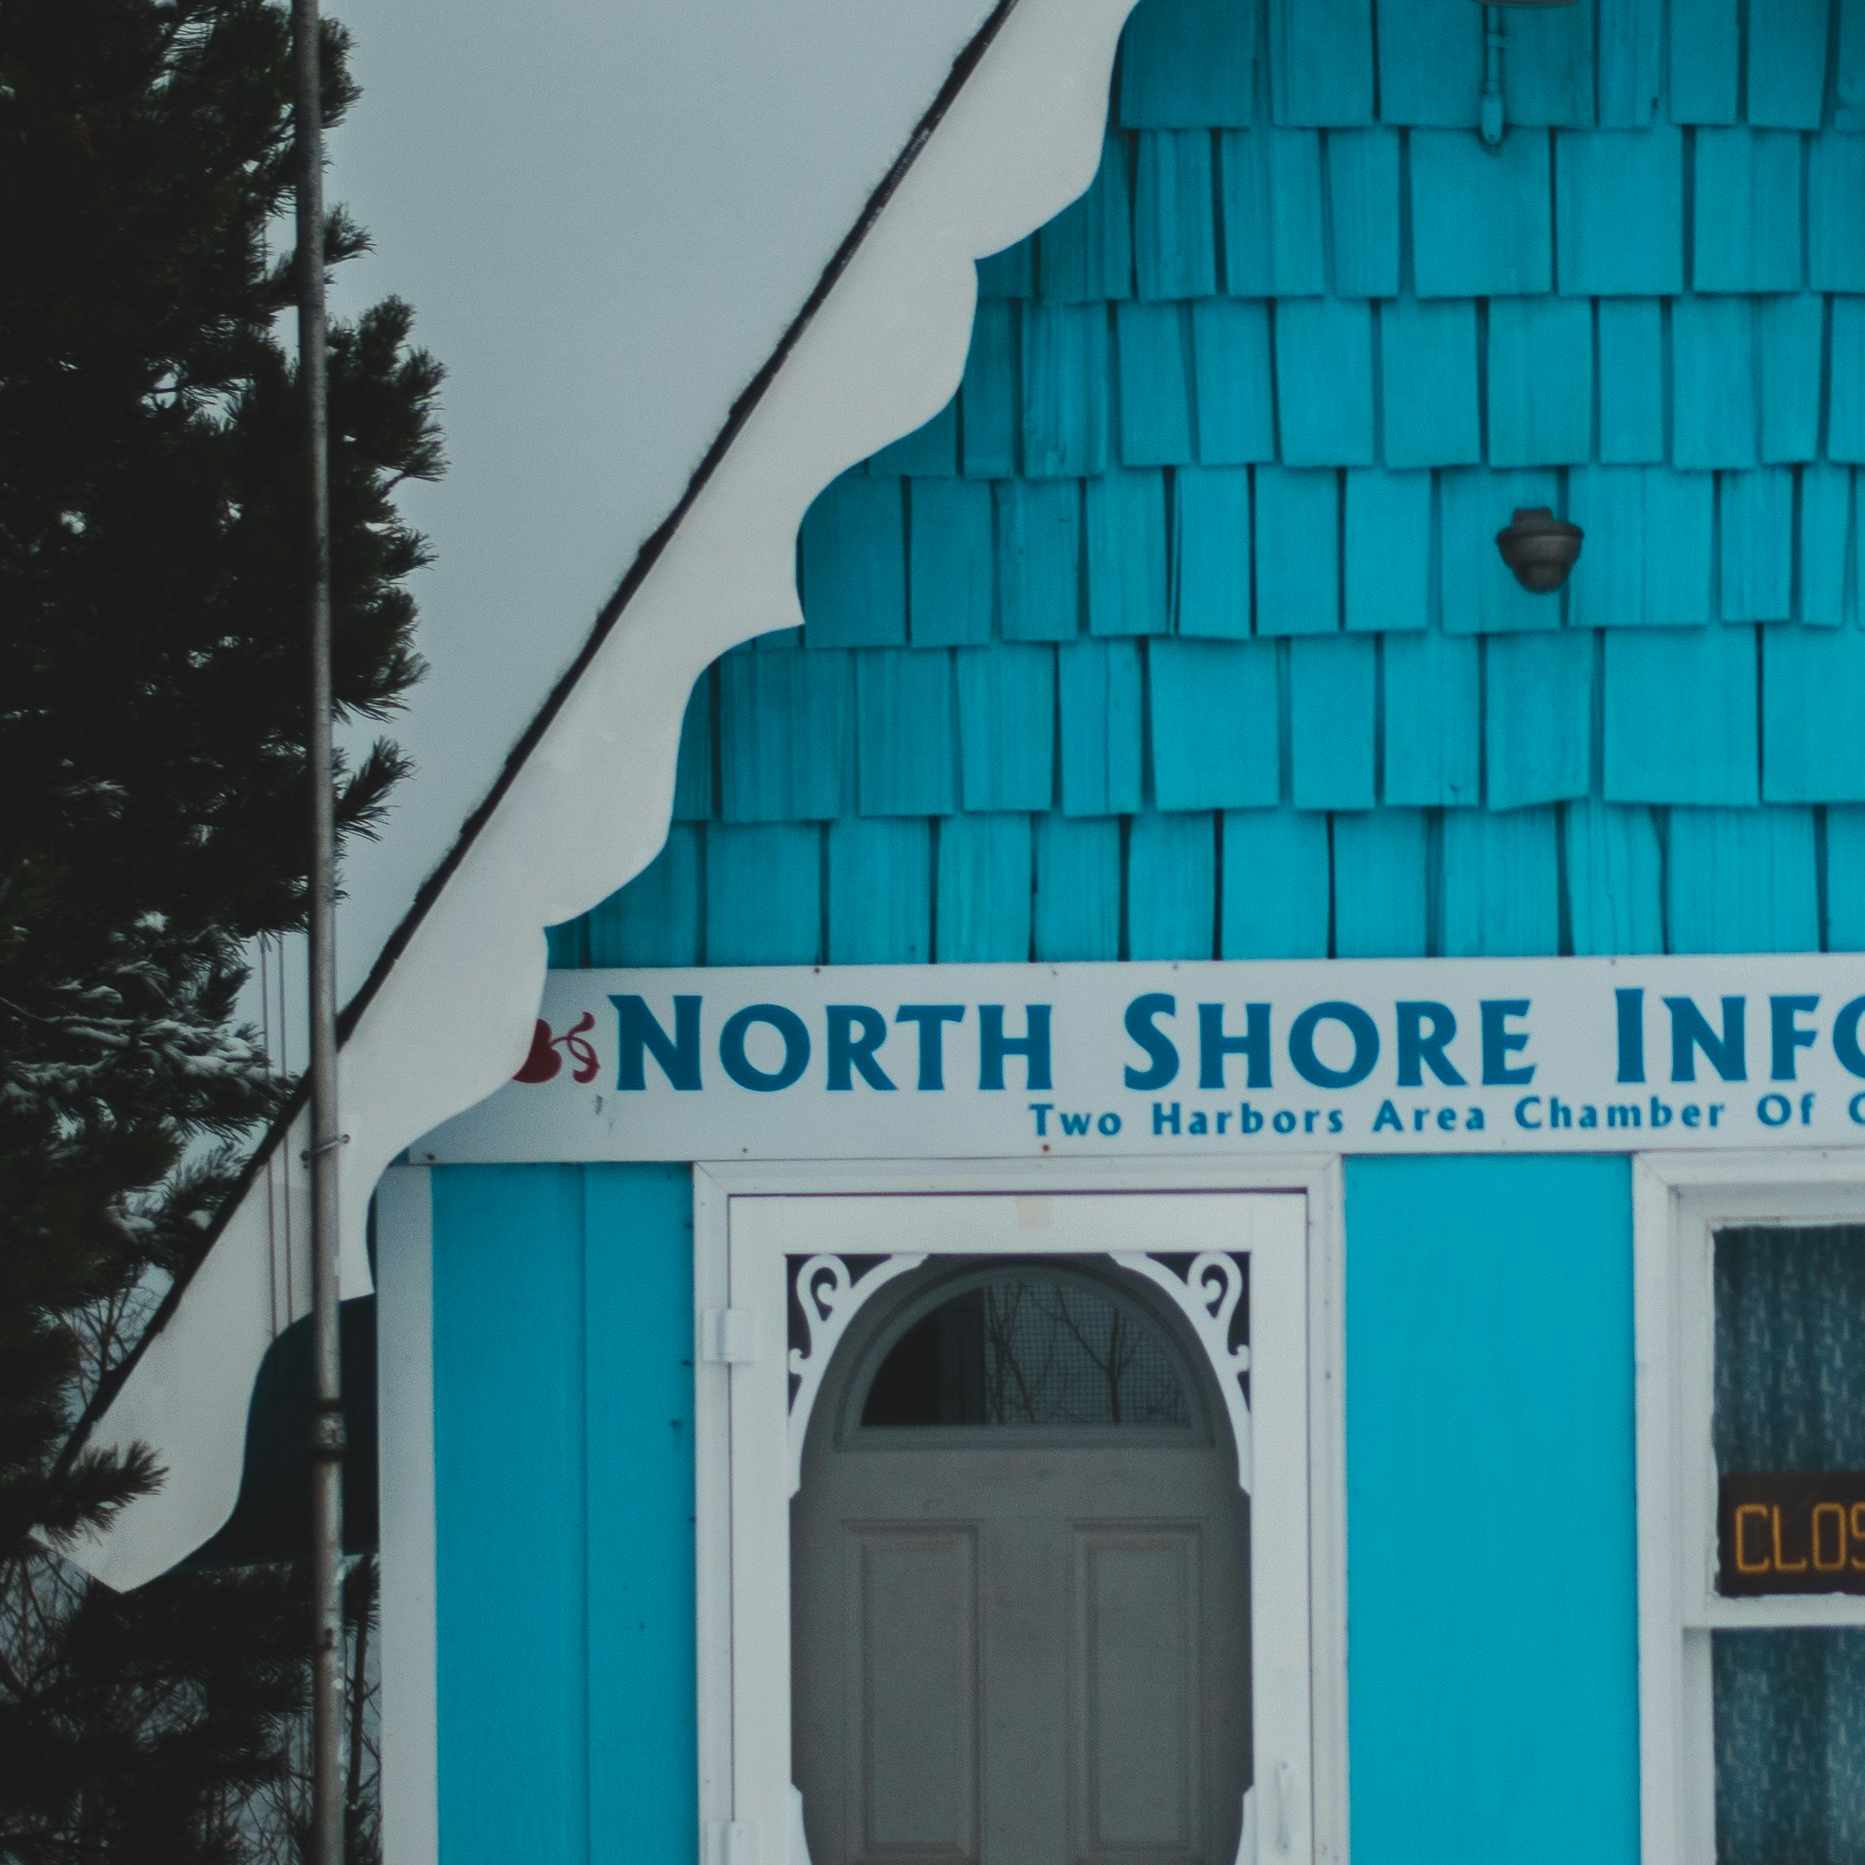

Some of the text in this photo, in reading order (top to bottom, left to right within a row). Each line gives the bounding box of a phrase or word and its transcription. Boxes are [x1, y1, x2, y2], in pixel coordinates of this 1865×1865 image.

[607, 993, 1053, 1092] NORTH
[1124, 992, 1537, 1091] SHORE
[1028, 1103, 1123, 1137] Two
[1152, 1101, 1345, 1136] Harbors
[1373, 1098, 1487, 1132] Area
[1514, 1095, 1726, 1130] Chamber
[1756, 1092, 1816, 1127] Of
